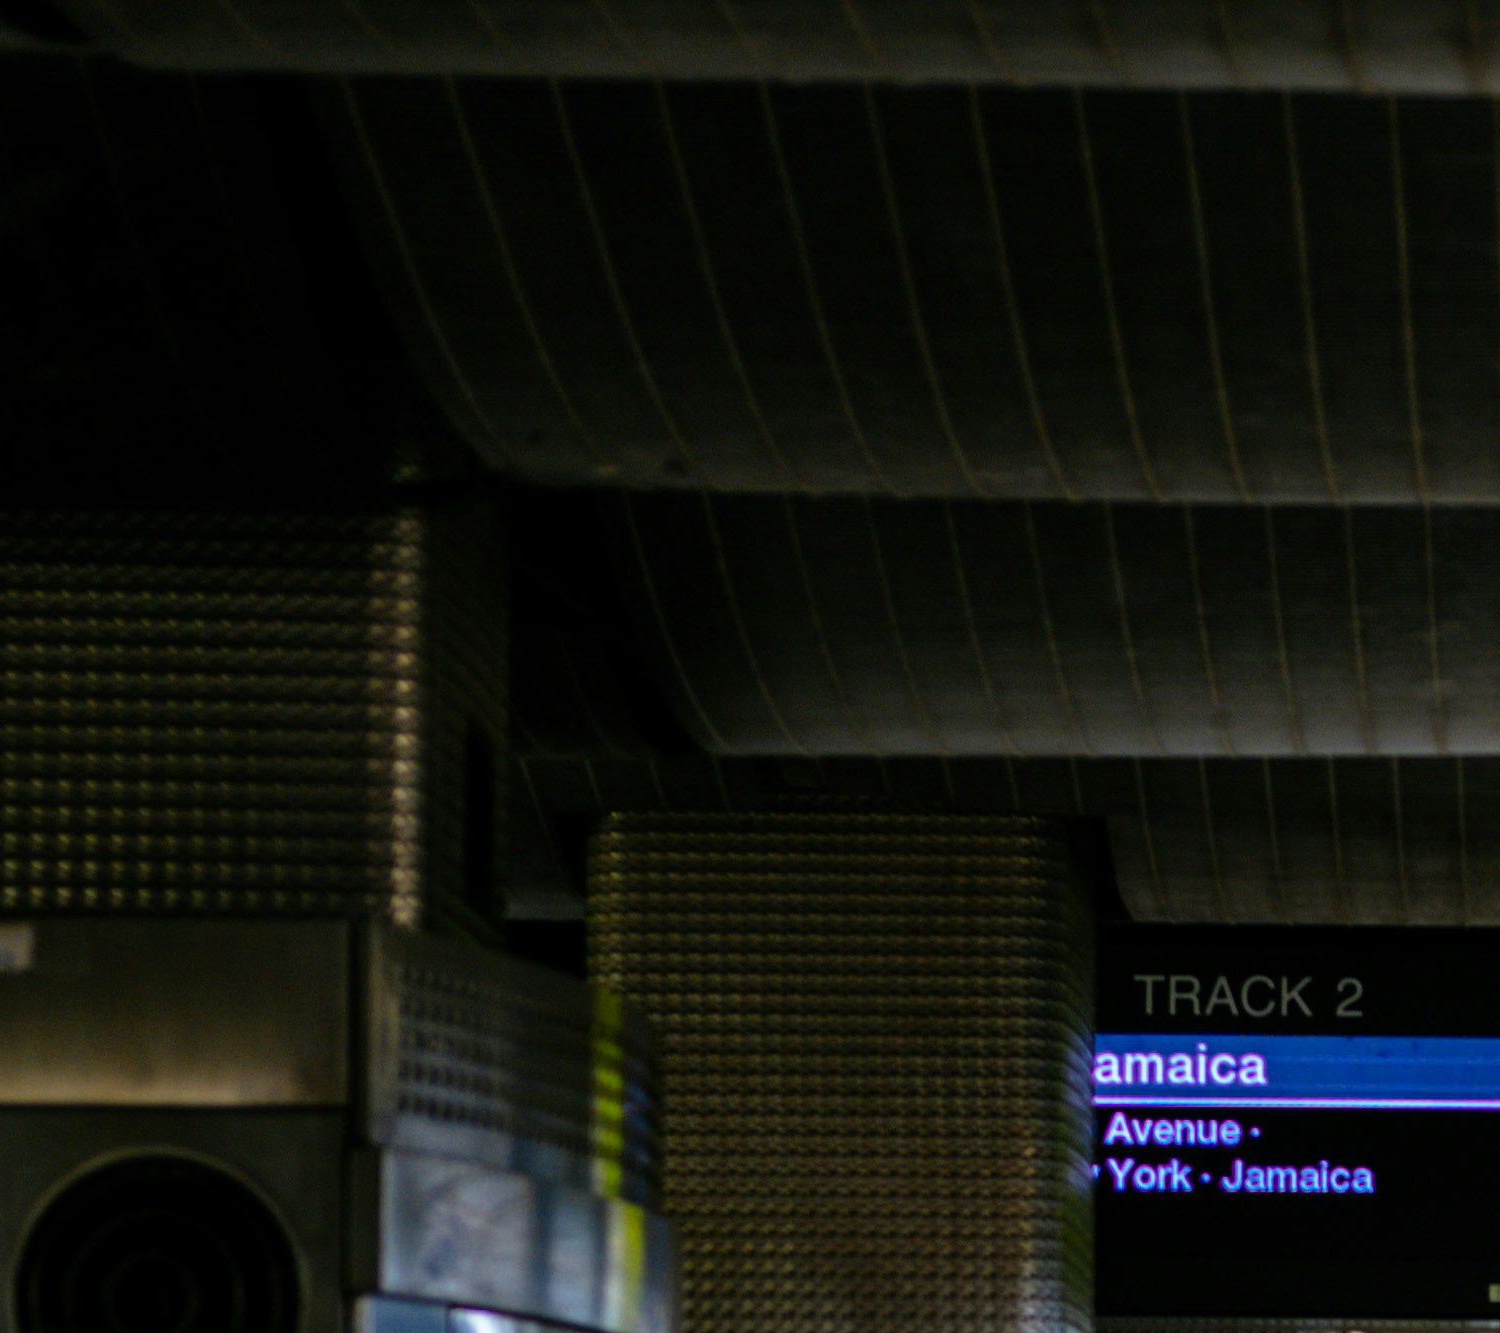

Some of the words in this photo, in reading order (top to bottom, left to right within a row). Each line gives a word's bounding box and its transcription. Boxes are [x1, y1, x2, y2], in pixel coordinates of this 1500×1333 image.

[1133, 974, 1313, 1018] TRACK
[1336, 976, 1364, 1018] 2
[1094, 1041, 1268, 1086] amaica
[1104, 1111, 1242, 1146] Avenue
[1105, 1157, 1194, 1193] York
[1220, 1158, 1375, 1194] Jamaica
